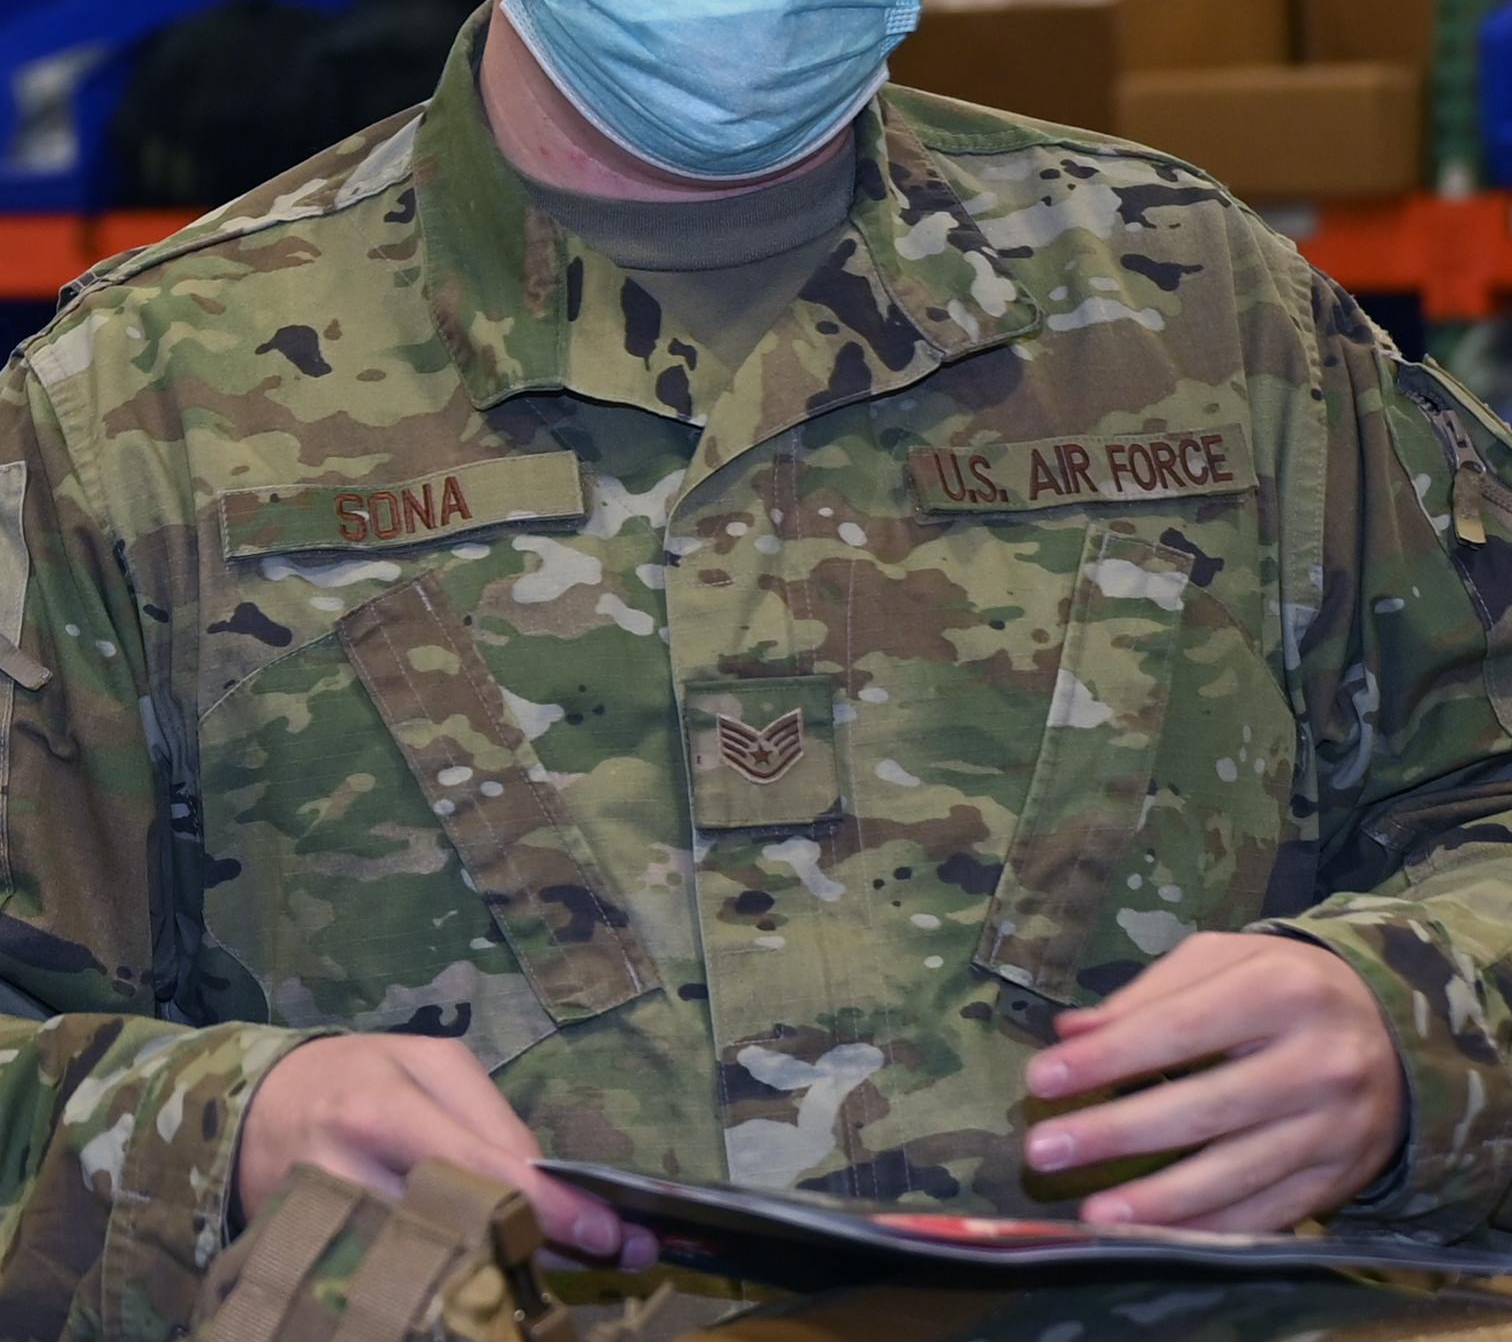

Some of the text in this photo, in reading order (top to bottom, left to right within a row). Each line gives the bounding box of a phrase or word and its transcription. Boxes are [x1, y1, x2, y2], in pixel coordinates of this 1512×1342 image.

[934, 434, 1234, 503] U.S. AIR FORCE
[336, 476, 473, 542] SONA
